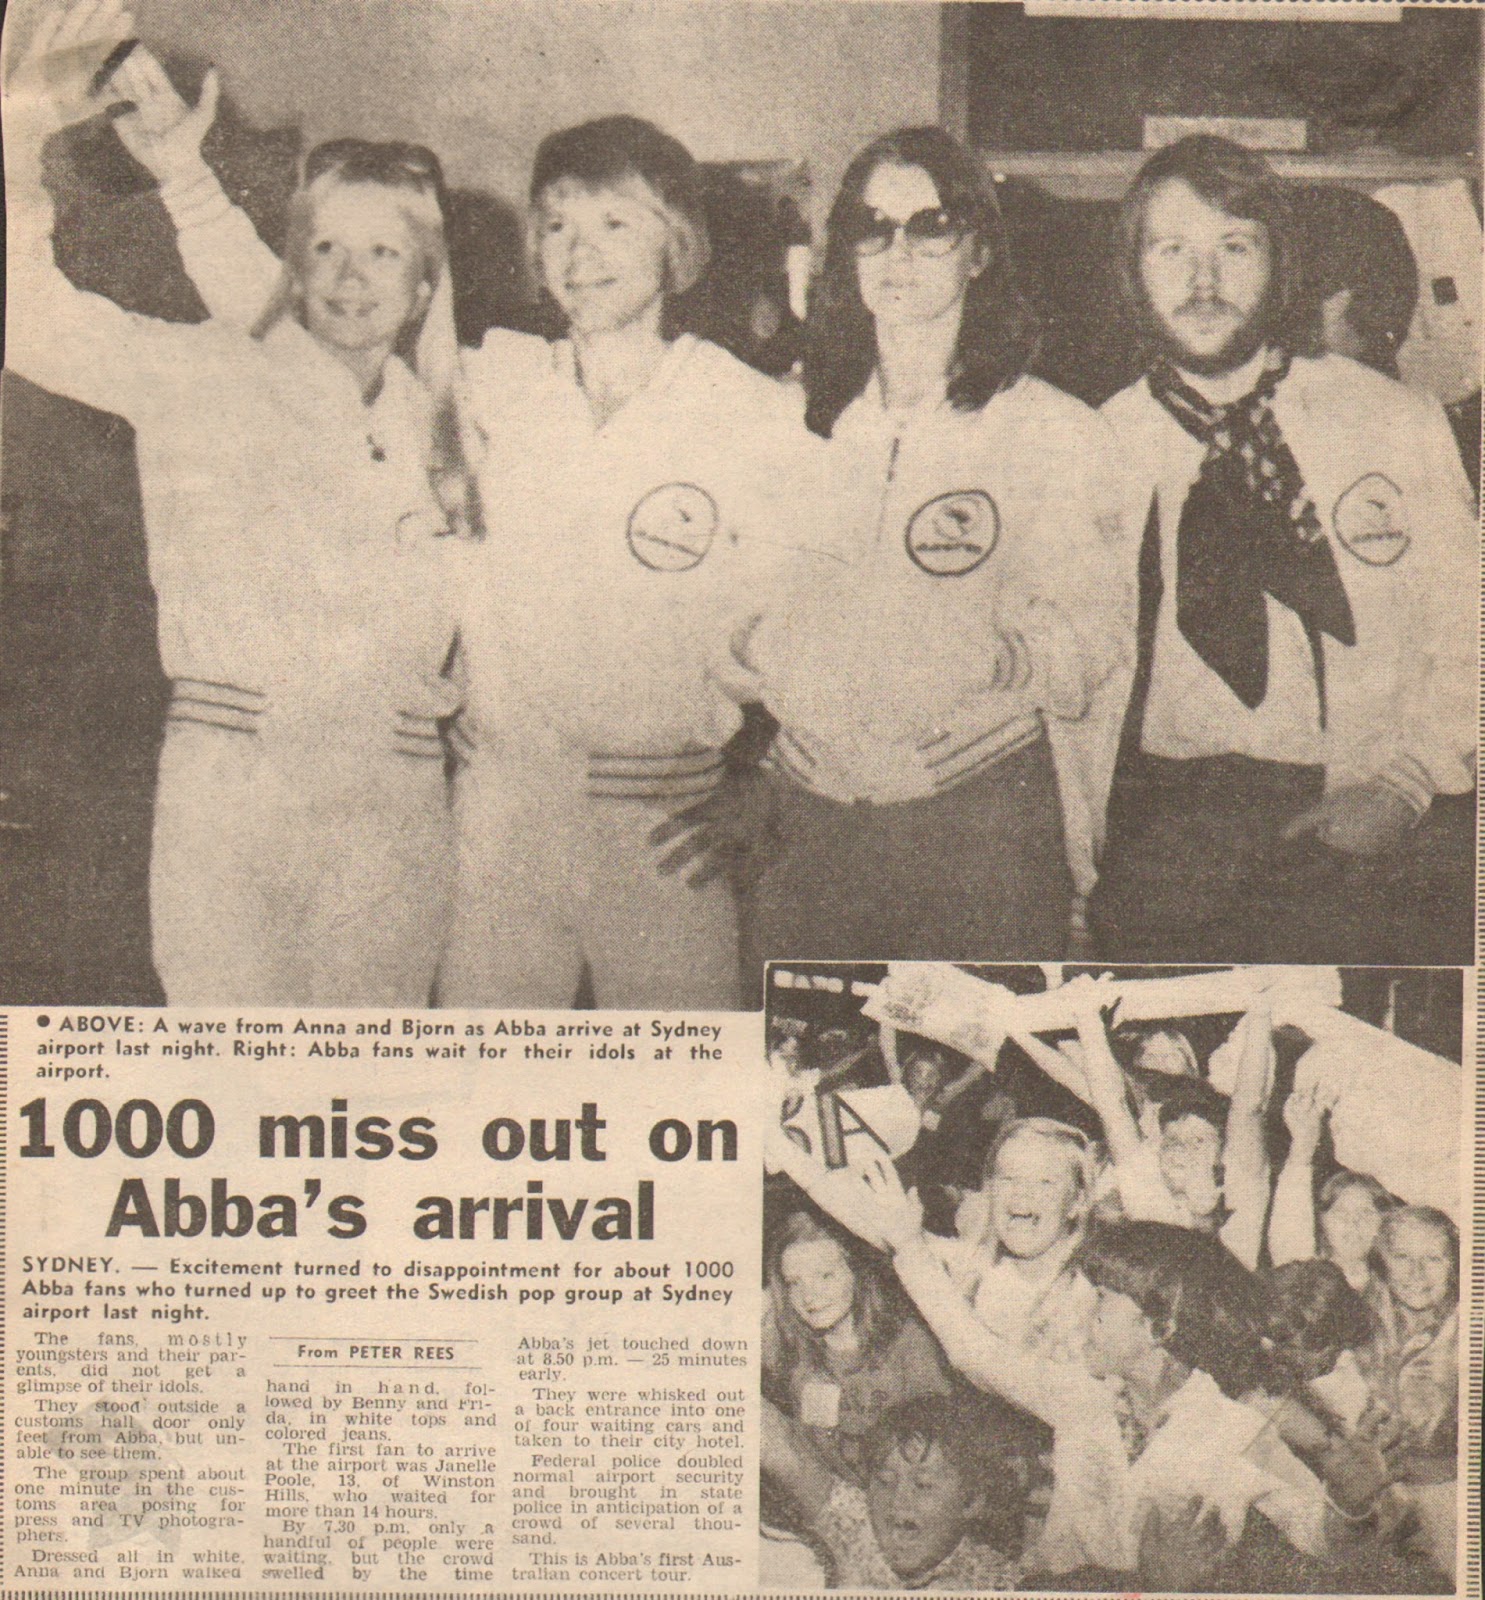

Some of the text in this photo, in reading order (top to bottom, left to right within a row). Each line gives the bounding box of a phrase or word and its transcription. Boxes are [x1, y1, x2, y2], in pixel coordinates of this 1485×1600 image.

[58, 1015, 722, 1040] ABOVE: A wave from Anna and Bjorn as Abba arrive at Sydney
[36, 1039, 723, 1061] airport last night. Right: Abba fans wait for their idols at the
[35, 1062, 111, 1083] airport.
[19, 1098, 738, 1161] 1000 miss out on
[104, 1179, 655, 1240] Abba's arrival
[22, 1257, 120, 1274] SYDNEY.
[169, 1258, 284, 1275] Excitement
[293, 1258, 361, 1276] turned
[372, 1258, 393, 1276] to
[403, 1259, 561, 1281] disappointment
[572, 1259, 603, 1277] for
[613, 1260, 672, 1277] about
[685, 1260, 735, 1278] 1000
[21, 1280, 734, 1306] Abba fans who turned up to greet the Swedish pop group at Sydney
[22, 1303, 210, 1324] airport last night.
[297, 1346, 455, 1359] From PETER REES
[517, 1336, 748, 1353] Abba's jet touched down
[16, 1348, 108, 1364] youngsters
[117, 1348, 149, 1361] and
[158, 1349, 201, 1362] their
[516, 1352, 535, 1365] at
[542, 1353, 575, 1366] 8.50
[652, 1353, 670, 1366] 25
[678, 1353, 748, 1366] minutes
[518, 1367, 566, 1383] early.
[16, 1379, 203, 1395] glimpse of their idols.
[532, 1388, 745, 1404] They were whisked out
[34, 1400, 78, 1416] They
[157, 1400, 219, 1413] outside
[236, 1404, 247, 1413] a
[14, 1415, 245, 1432] customs hall door only
[264, 1427, 391, 1443] colored jeans.
[514, 1434, 744, 1451] taken to their city hotel.
[16, 1446, 52, 1459] able
[57, 1446, 75, 1459] to
[79, 1450, 107, 1459] see
[283, 1443, 497, 1457] The first fan to arrive
[265, 1458, 497, 1474] at the airport was Janelle
[531, 1455, 743, 1471] Federal police doubled
[33, 1466, 246, 1483] The group spent about
[512, 1470, 744, 1486] normal airport security
[14, 1485, 45, 1495] one
[59, 1482, 121, 1495] minute
[134, 1482, 153, 1495] in
[166, 1483, 195, 1496] the
[265, 1504, 438, 1518] more than 14 hours.
[14, 1517, 58, 1529] press
[71, 1514, 104, 1527] and
[121, 1514, 144, 1527] TV
[282, 1520, 305, 1536] By
[326, 1520, 356, 1533] 7.30
[428, 1521, 466, 1537] only
[484, 1524, 495, 1534] a
[529, 1552, 568, 1565] This
[574, 1552, 589, 1565] is
[595, 1553, 652, 1566] Abba's
[658, 1553, 695, 1566] first
[352, 1567, 371, 1583] by
[399, 1567, 428, 1580] the
[454, 1567, 494, 1580] time
[578, 1568, 643, 1581] concert
[651, 1568, 691, 1581] tour.
